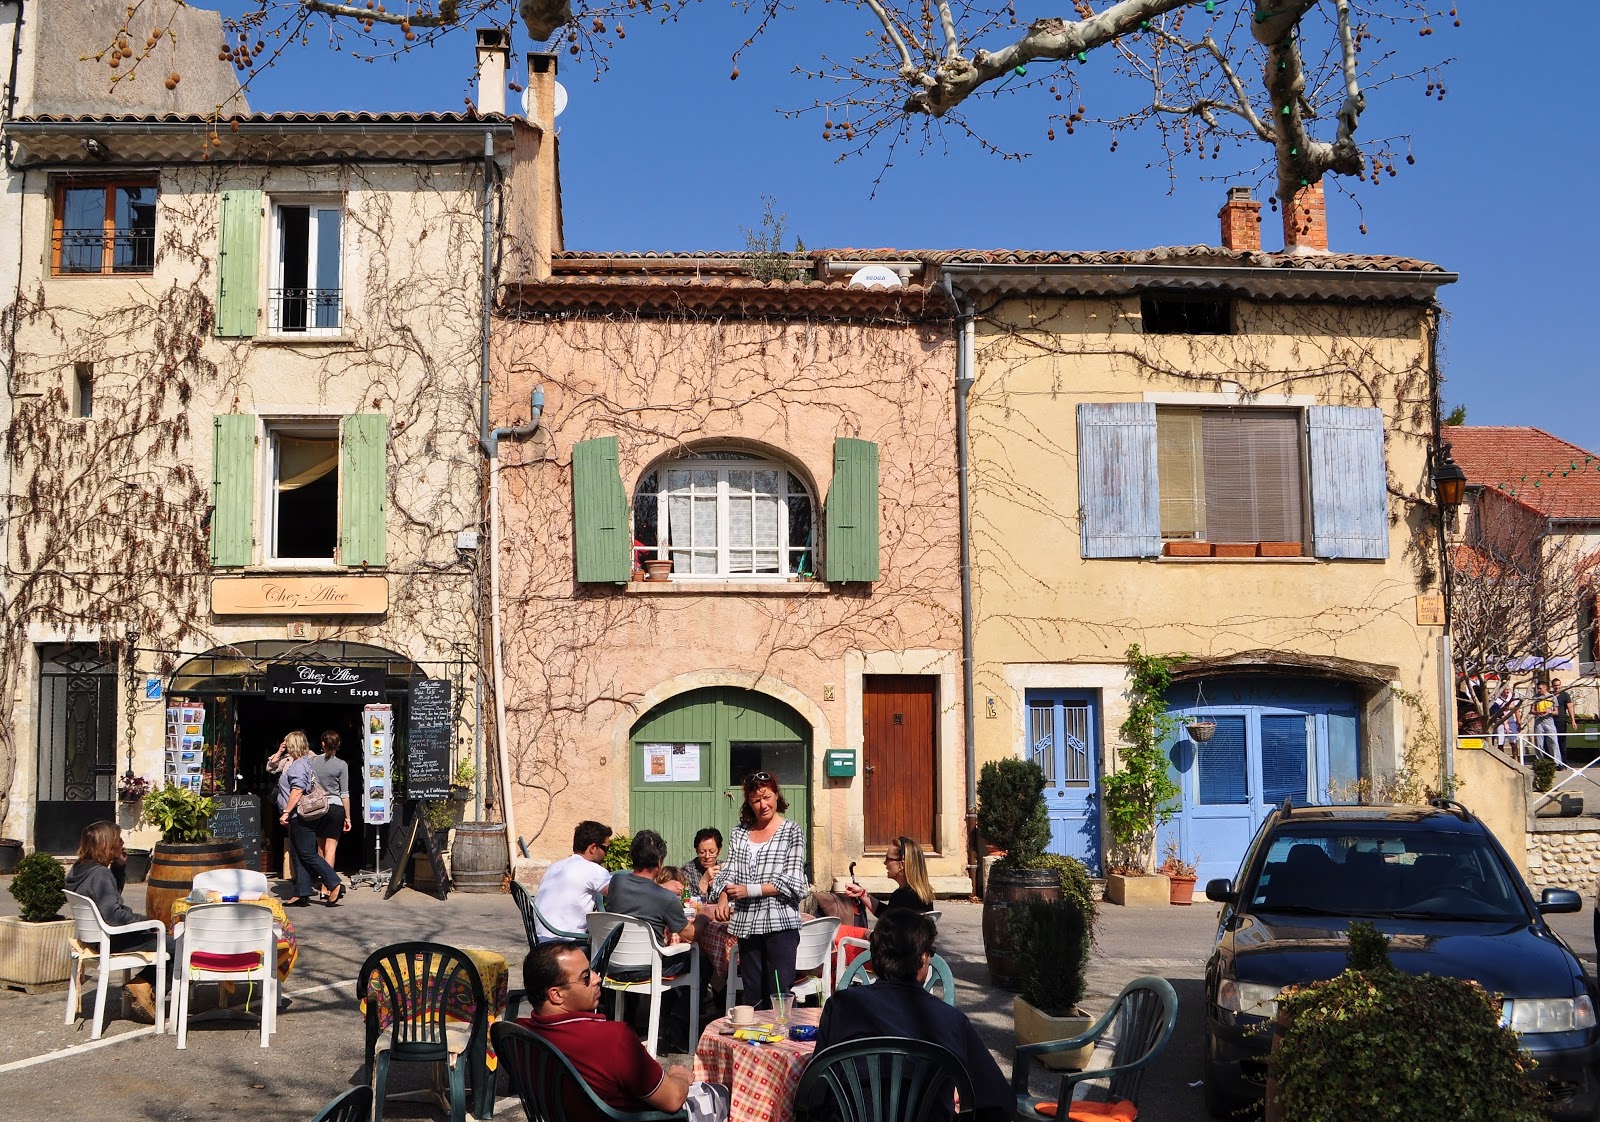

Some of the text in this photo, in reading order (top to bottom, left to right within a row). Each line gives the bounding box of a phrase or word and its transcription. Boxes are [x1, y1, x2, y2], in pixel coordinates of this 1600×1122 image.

[261, 583, 349, 609] Chez Alice
[297, 665, 360, 685] Chez Alice
[272, 686, 296, 694] Petit
[301, 687, 322, 695] café
[350, 689, 379, 697] Expos
[214, 812, 241, 821] Vanille
